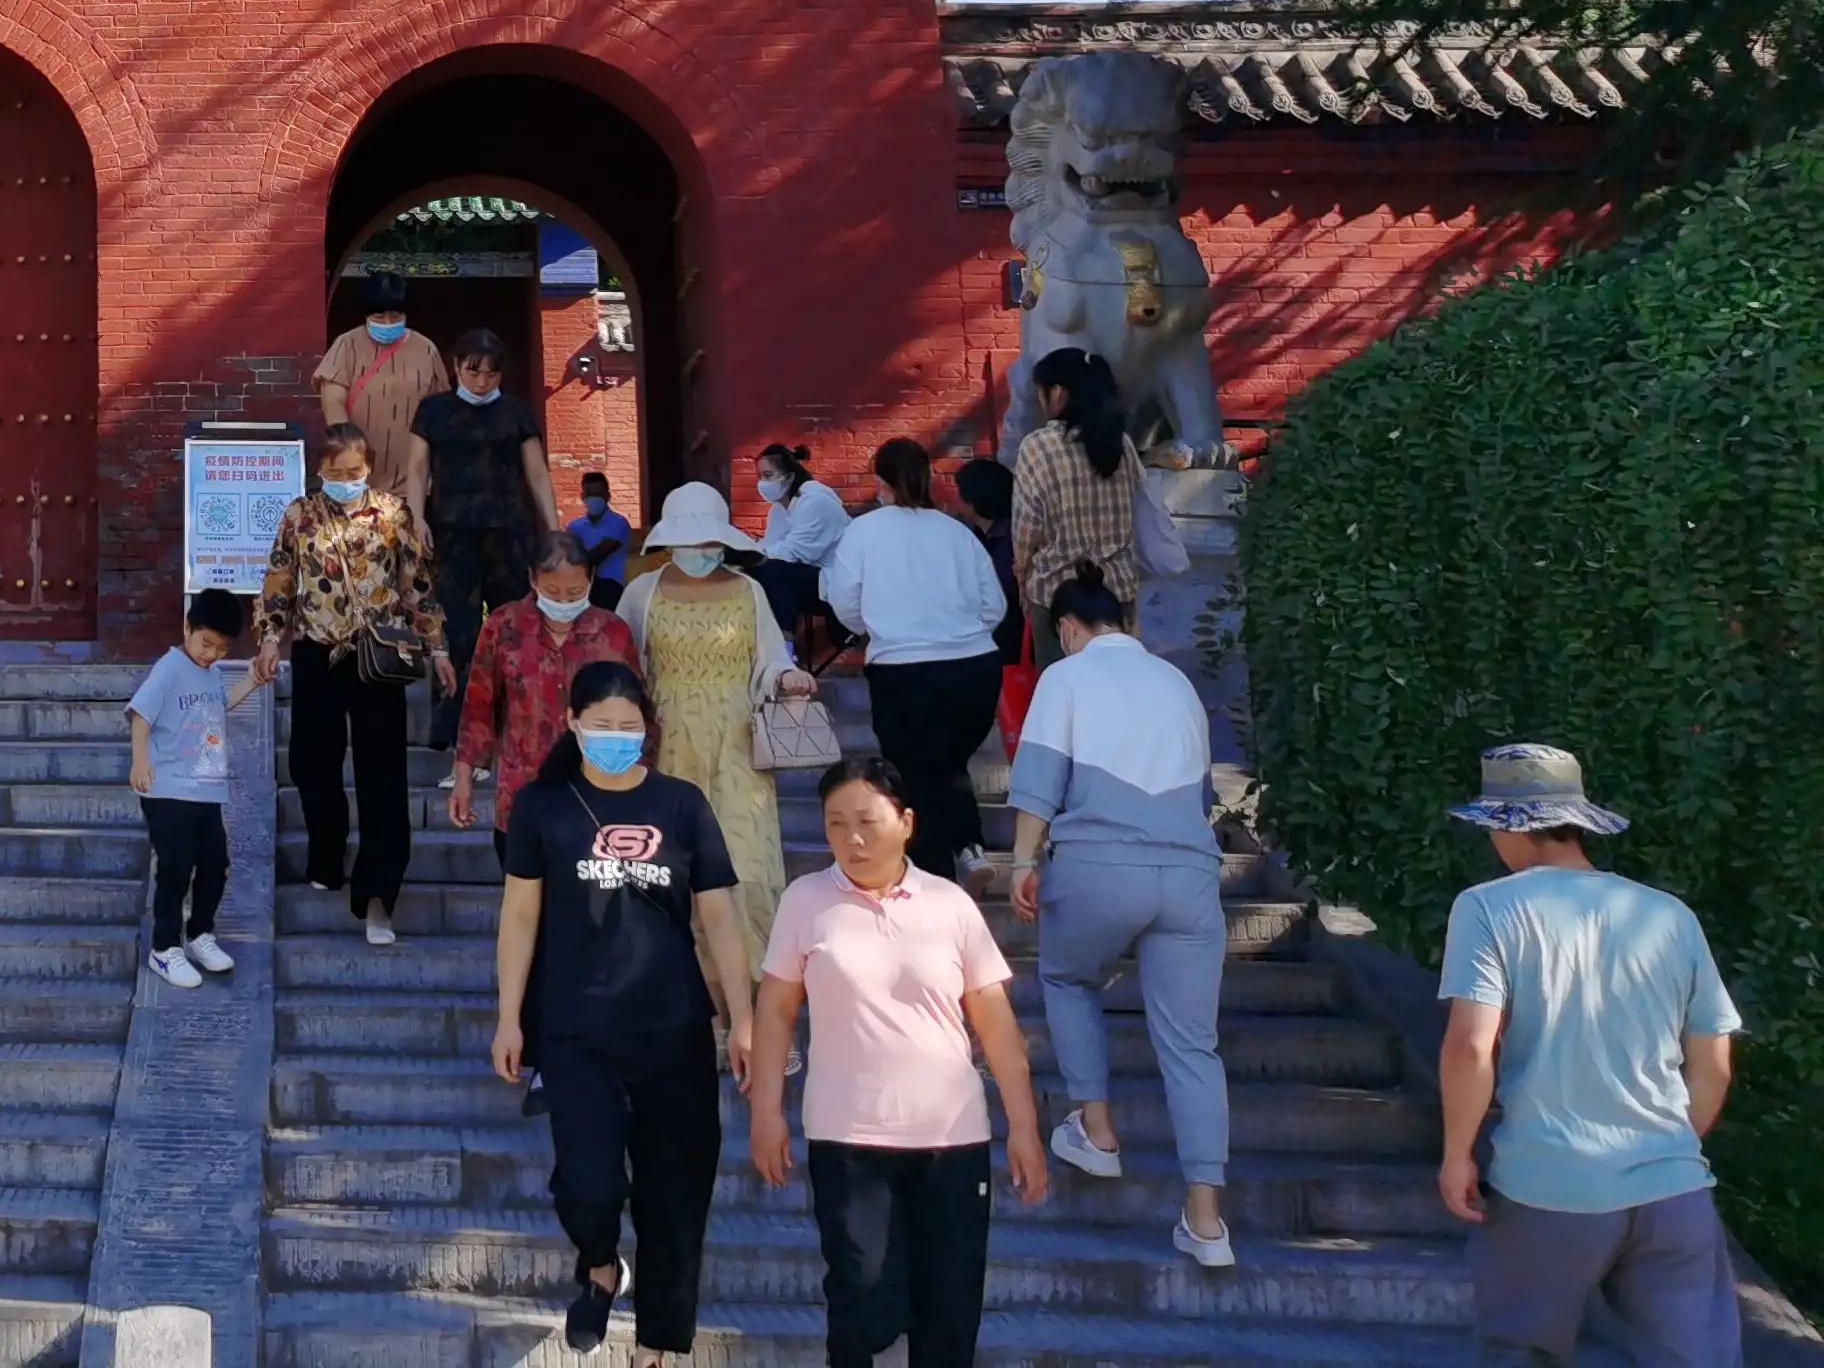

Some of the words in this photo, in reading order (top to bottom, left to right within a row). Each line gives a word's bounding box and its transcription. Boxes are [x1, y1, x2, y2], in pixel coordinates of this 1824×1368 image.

[205, 455, 285, 467] 疫情防控期间
[205, 470, 285, 482] 请您扫码进出
[576, 860, 672, 887] SKECHERS
[599, 878, 617, 889] LOS
